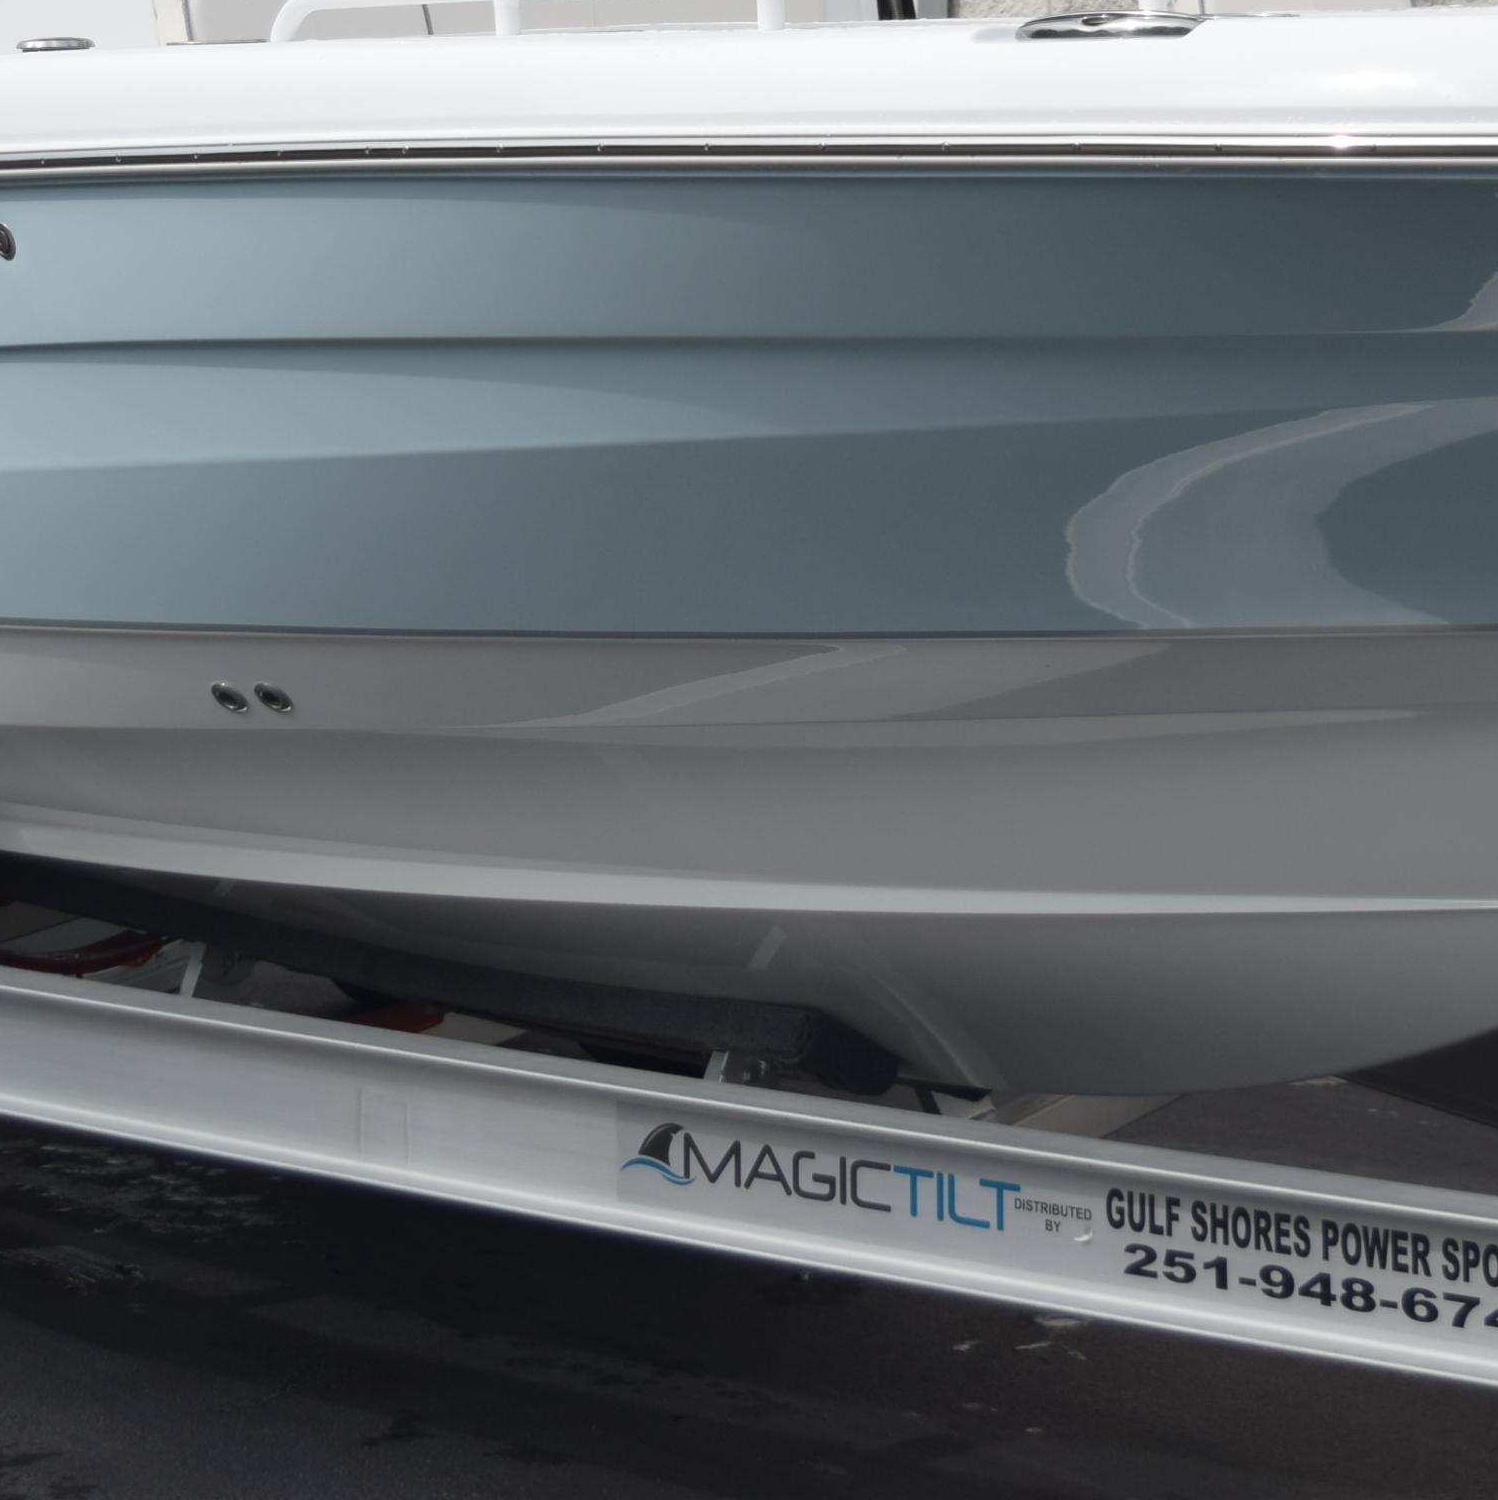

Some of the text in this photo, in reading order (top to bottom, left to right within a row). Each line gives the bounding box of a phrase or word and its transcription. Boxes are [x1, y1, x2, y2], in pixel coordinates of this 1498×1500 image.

[682, 1131, 1021, 1232] MAGICTILT
[1013, 1196, 1093, 1221] DISTRIBUTED
[1044, 1218, 1061, 1233] BY
[1105, 1187, 1181, 1237] GULF
[1190, 1199, 1312, 1258] SHORES
[1321, 1219, 1432, 1278] POWER
